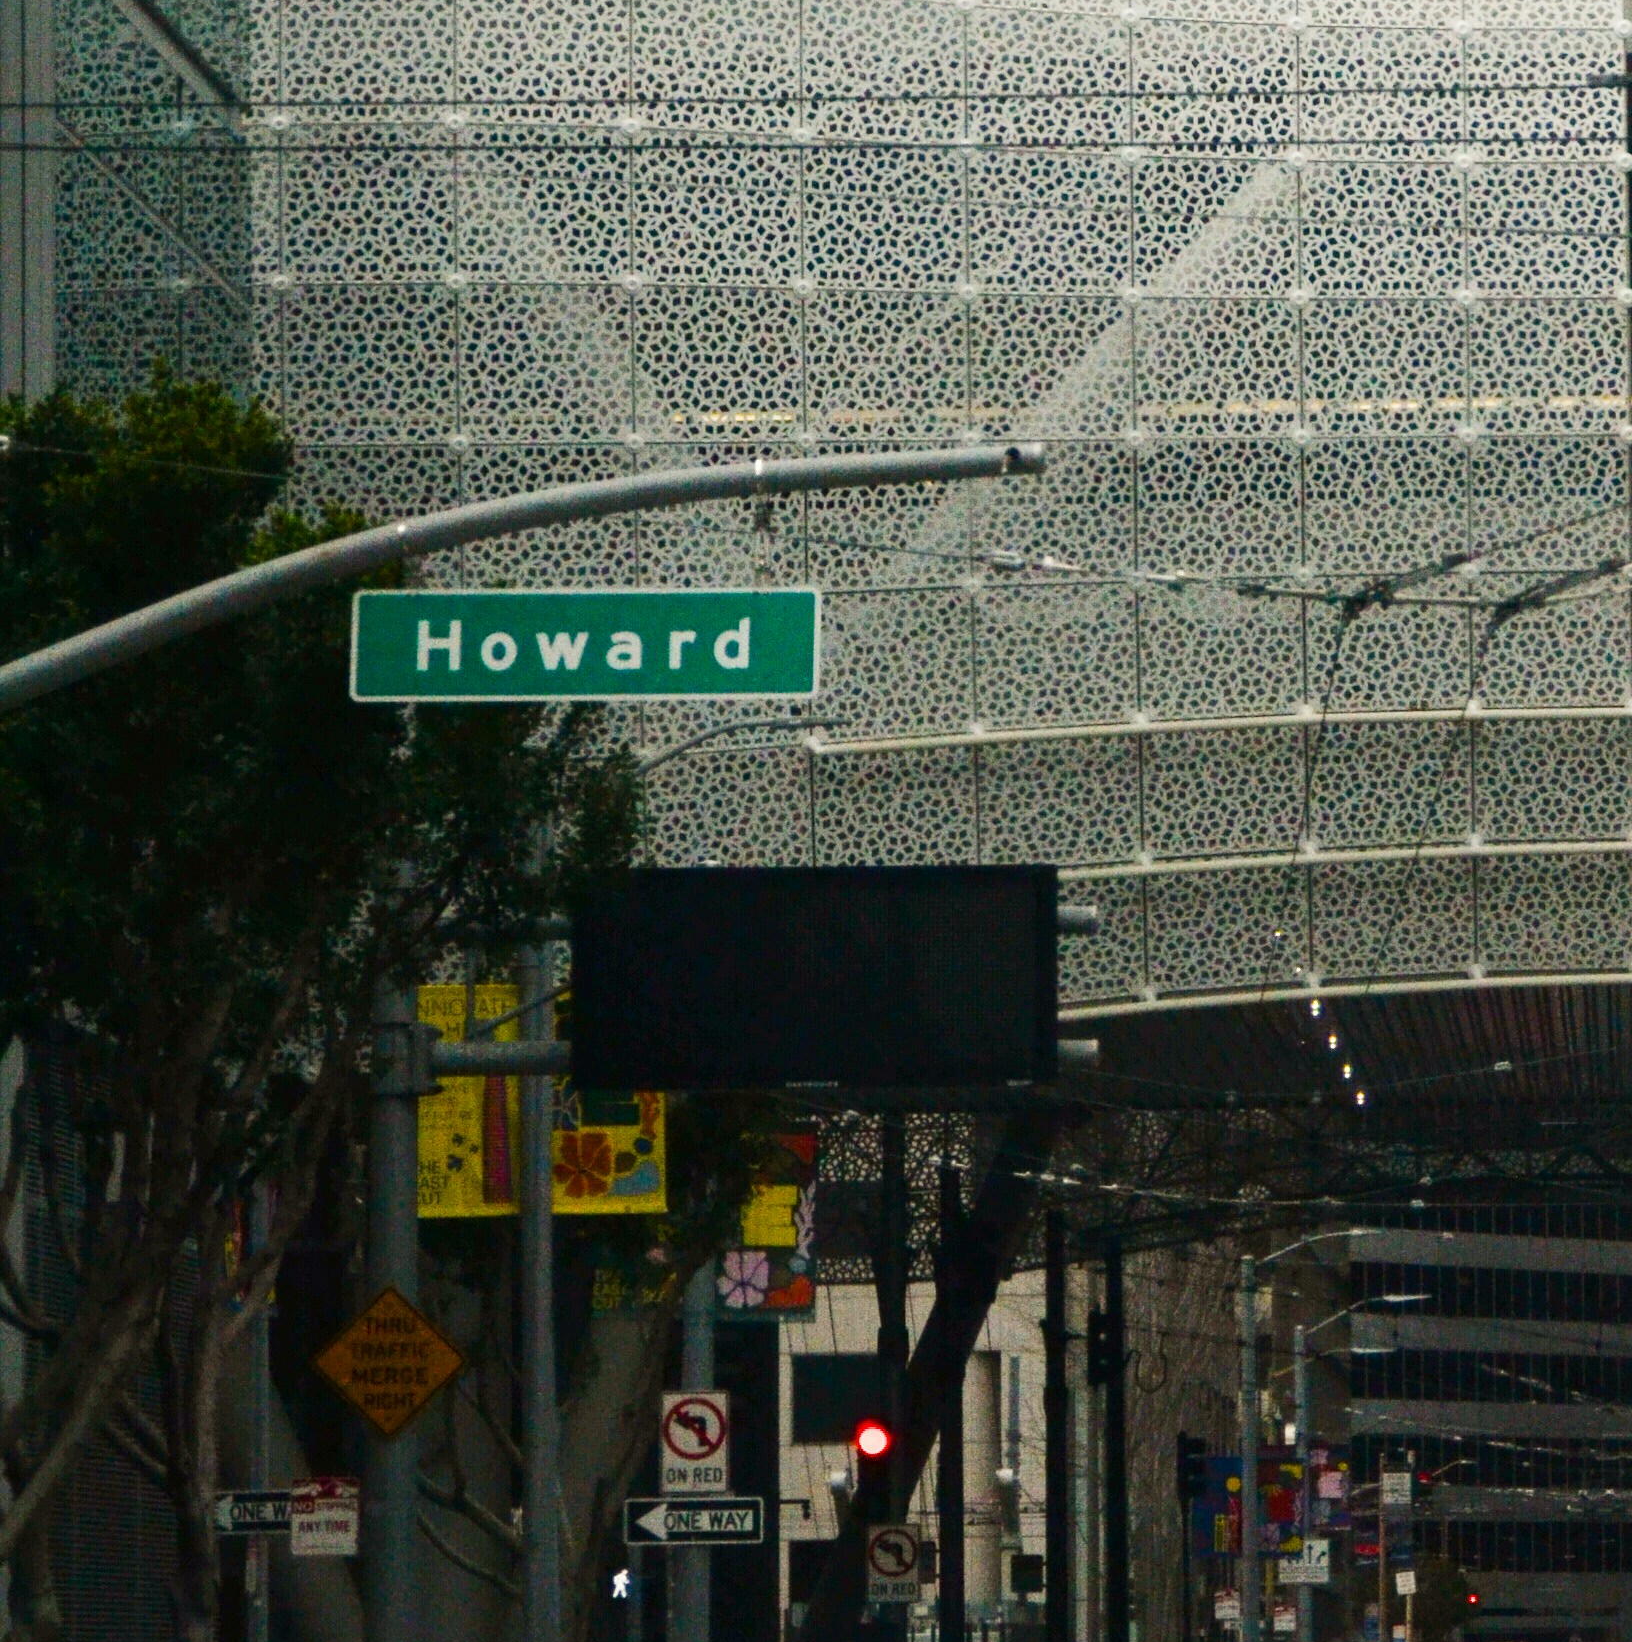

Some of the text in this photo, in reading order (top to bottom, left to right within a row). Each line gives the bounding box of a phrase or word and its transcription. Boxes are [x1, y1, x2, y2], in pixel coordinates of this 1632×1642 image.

[416, 617, 751, 672] Howard
[364, 1317, 416, 1334] THRU
[351, 1342, 429, 1358] TRAFFIC
[351, 1367, 429, 1385] MERGE
[364, 1393, 416, 1409] RIGHT
[666, 1467, 722, 1483] ON RED
[230, 1504, 266, 1520] ONE
[293, 1501, 313, 1512] NO
[299, 1520, 350, 1533] ANY TIME
[664, 1512, 748, 1530] ONE WAY
